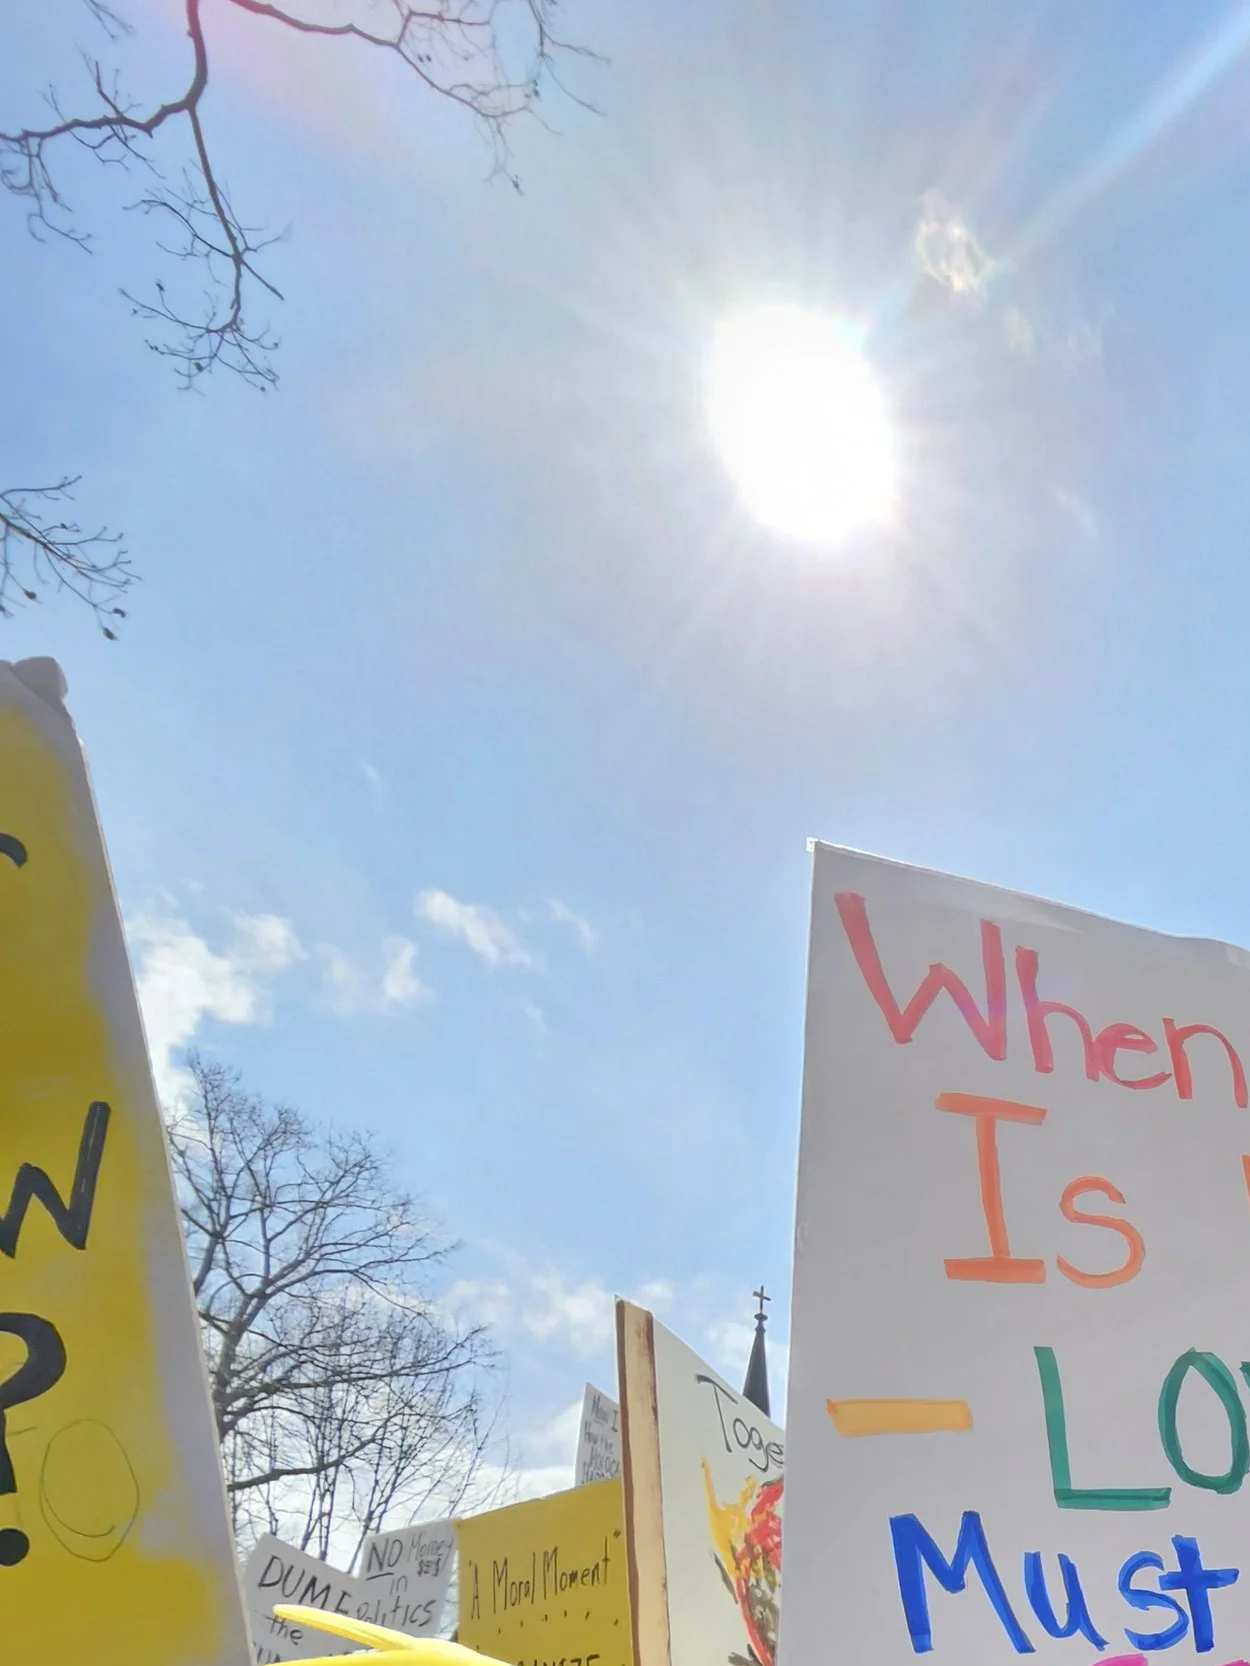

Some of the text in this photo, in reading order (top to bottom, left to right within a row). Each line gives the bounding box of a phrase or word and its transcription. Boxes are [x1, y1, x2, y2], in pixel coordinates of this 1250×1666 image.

[837, 893, 1249, 1109] When
[936, 1092, 1145, 1288] Is
[695, 1373, 785, 1472] Toge
[367, 1538, 403, 1573] NO
[492, 1551, 536, 1615] Moral
[889, 1511, 1241, 1655] Must
